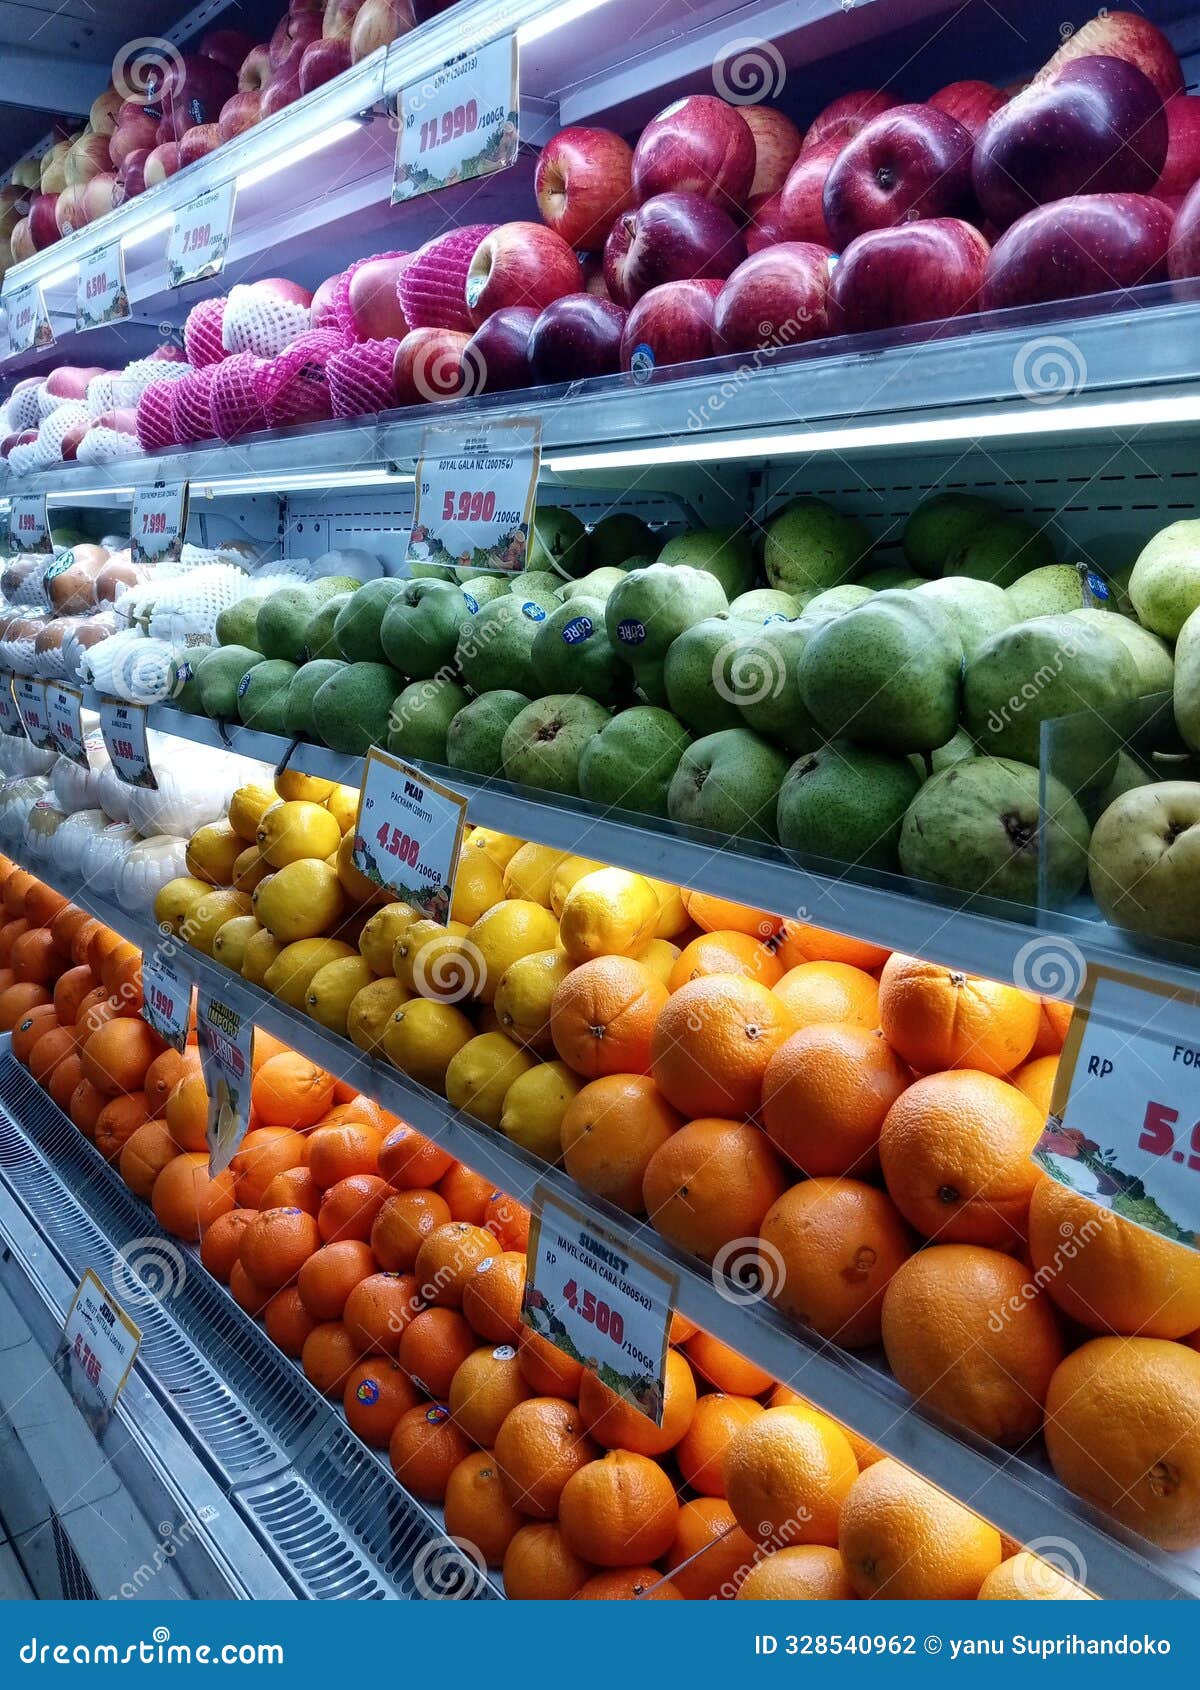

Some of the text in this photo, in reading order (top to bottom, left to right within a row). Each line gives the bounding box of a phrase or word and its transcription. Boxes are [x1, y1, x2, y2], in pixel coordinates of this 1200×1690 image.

[419, 99, 505, 153] 11.990 /100GR
[438, 460, 457, 470] ROYAL
[458, 459, 475, 470] GALA
[475, 459, 484, 470] NZ
[422, 483, 430, 495] RP
[442, 490, 521, 524] 5.990 /100GR
[143, 513, 167, 535] 7.990
[563, 617, 593, 643] CORE
[618, 624, 646, 638] CORE
[365, 798, 375, 810] RP
[404, 781, 423, 803] PEAR
[376, 822, 442, 884] 4.500 /100GR
[150, 984, 174, 1022] 1.990
[207, 1006, 240, 1041] IMPORT
[1087, 1055, 1114, 1078] RP
[546, 1250, 557, 1266] RP
[557, 1234, 579, 1260] NAVEL
[579, 1250, 598, 1273] CARA
[598, 1264, 618, 1286] CARA
[578, 1231, 629, 1275] SUNKIST
[562, 1278, 624, 1345] 4.500
[622, 1341, 655, 1374] /100GR
